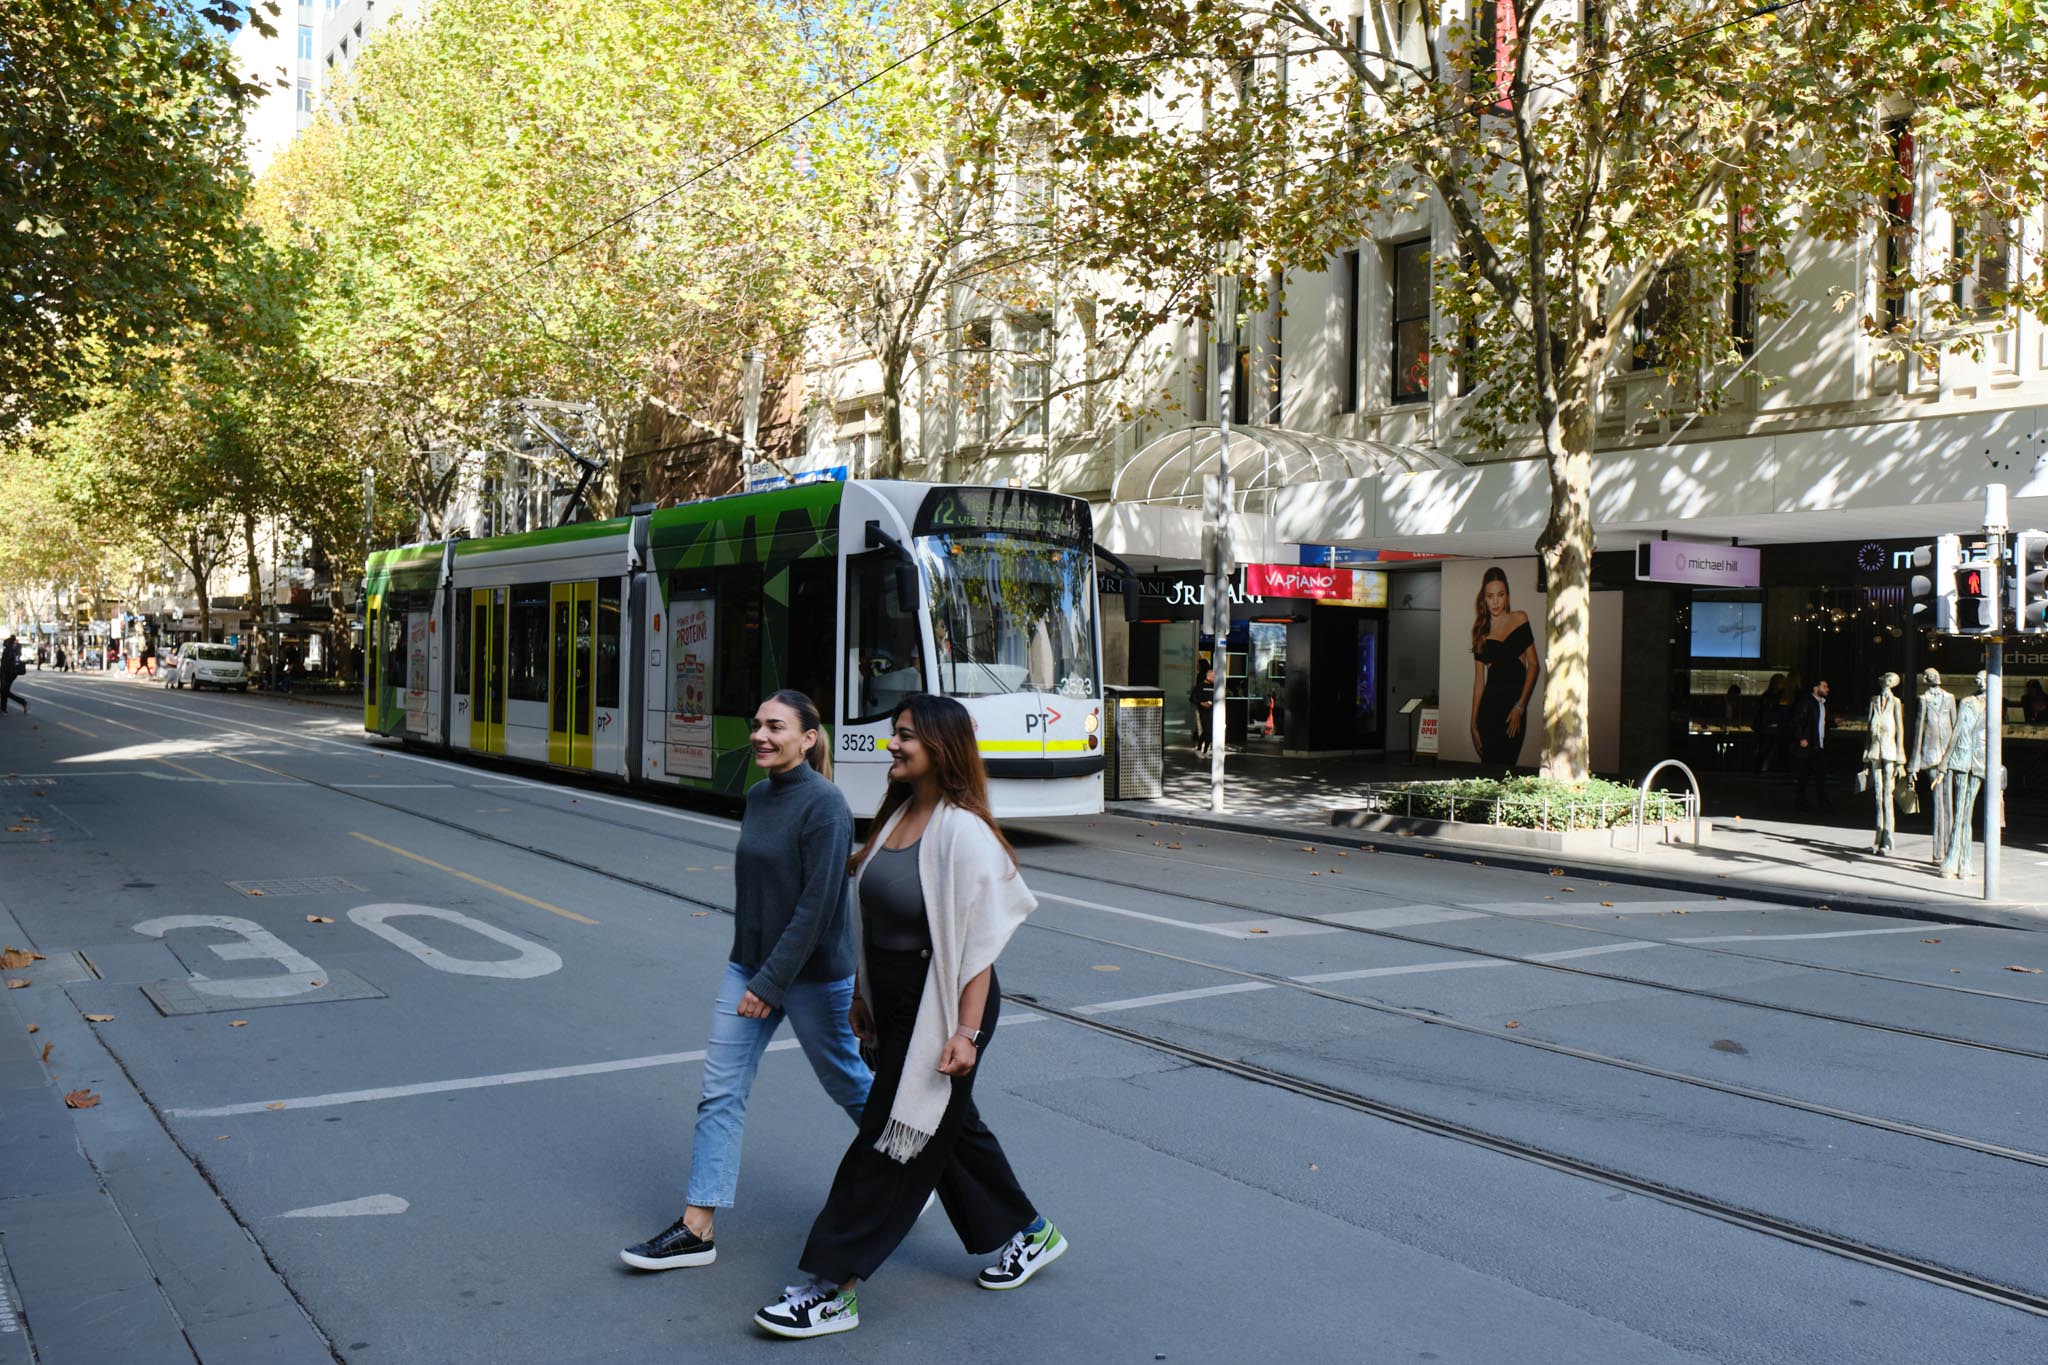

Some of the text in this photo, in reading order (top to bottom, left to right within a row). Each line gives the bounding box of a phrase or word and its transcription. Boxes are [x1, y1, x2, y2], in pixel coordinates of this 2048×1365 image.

[958, 513, 977, 527] via
[984, 515, 1046, 531] Swanston
[1688, 558, 1738, 572] michael hill
[676, 620, 707, 648] PROTEIN!
[1061, 678, 1093, 695] 3523
[1421, 728, 1438, 736] OPEN
[842, 733, 875, 752] 3523
